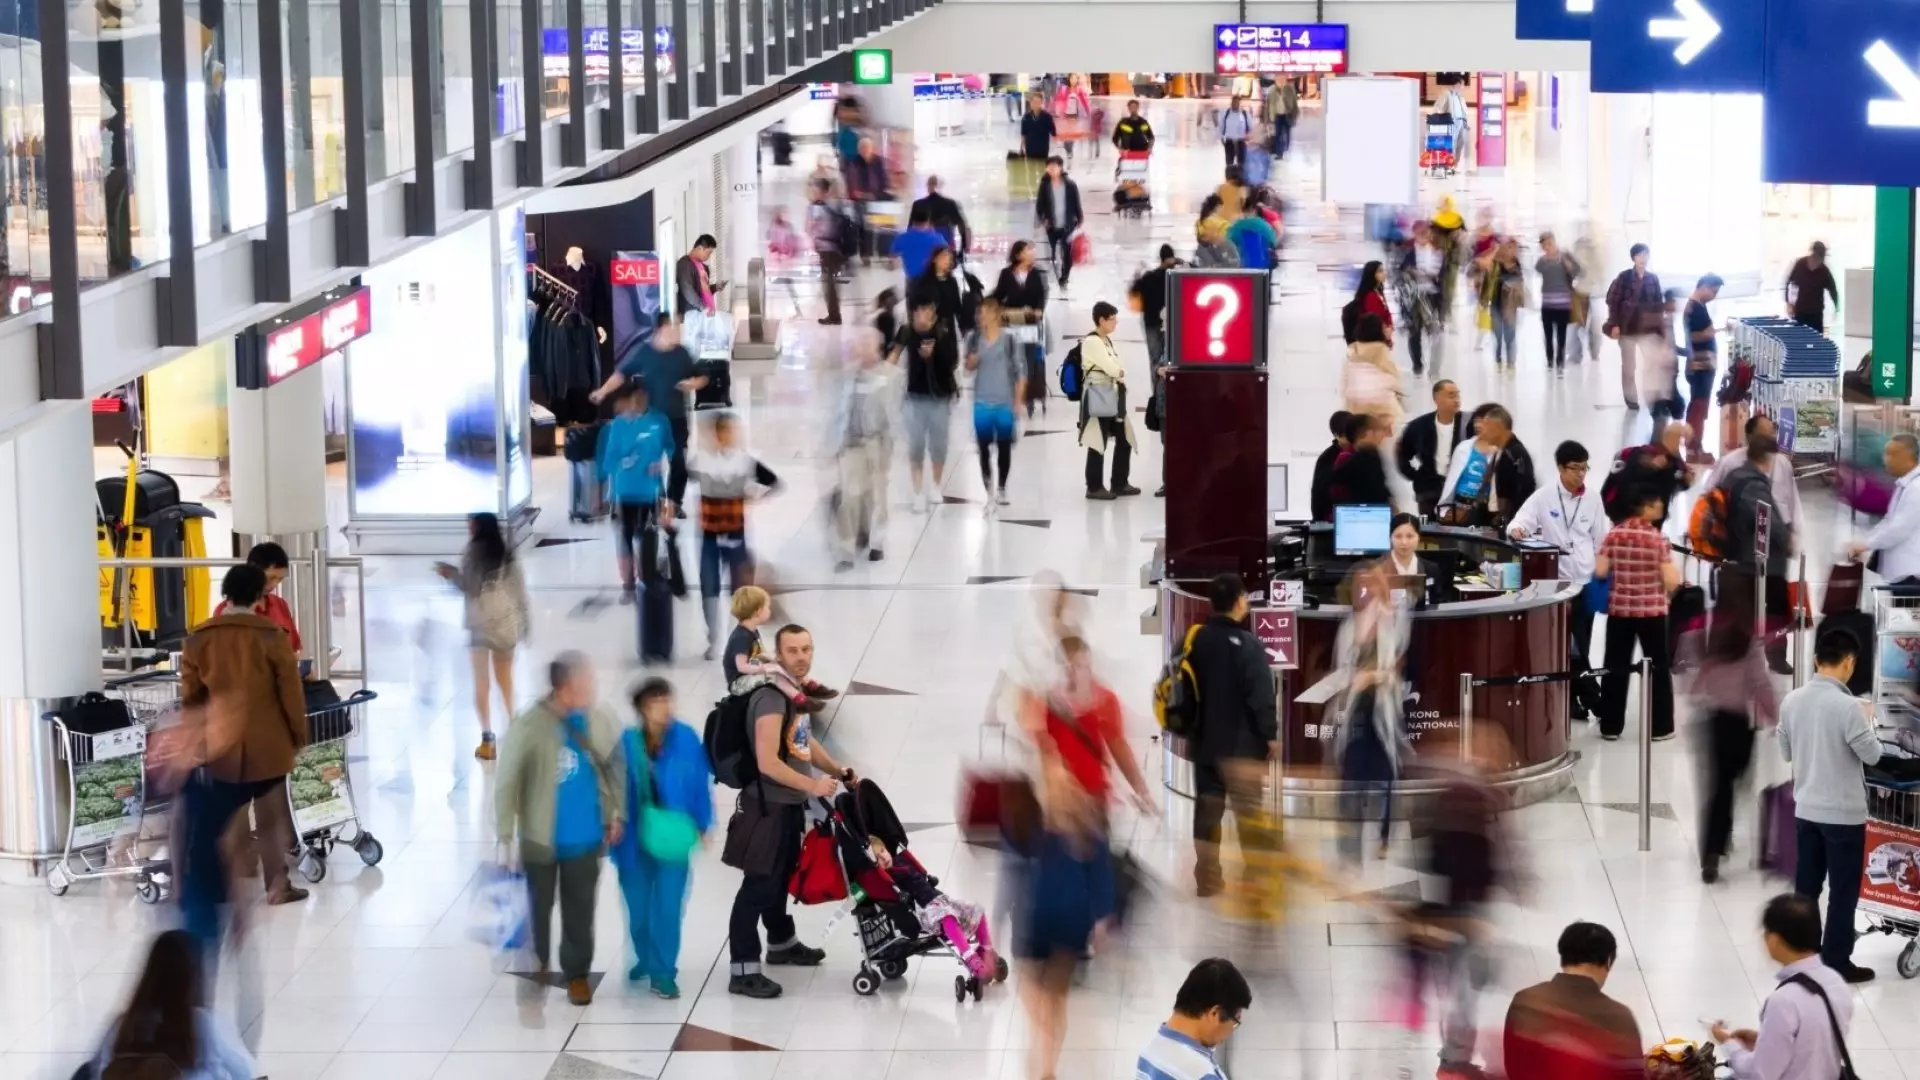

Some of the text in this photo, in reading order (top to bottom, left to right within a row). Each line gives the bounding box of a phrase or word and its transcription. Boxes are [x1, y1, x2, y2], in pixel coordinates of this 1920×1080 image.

[1282, 30, 1311, 48] 1-4
[615, 263, 658, 280] SALE
[1258, 617, 1290, 630] 入口
[1409, 710, 1440, 719] KONG
[1407, 720, 1461, 729] NATIONAL
